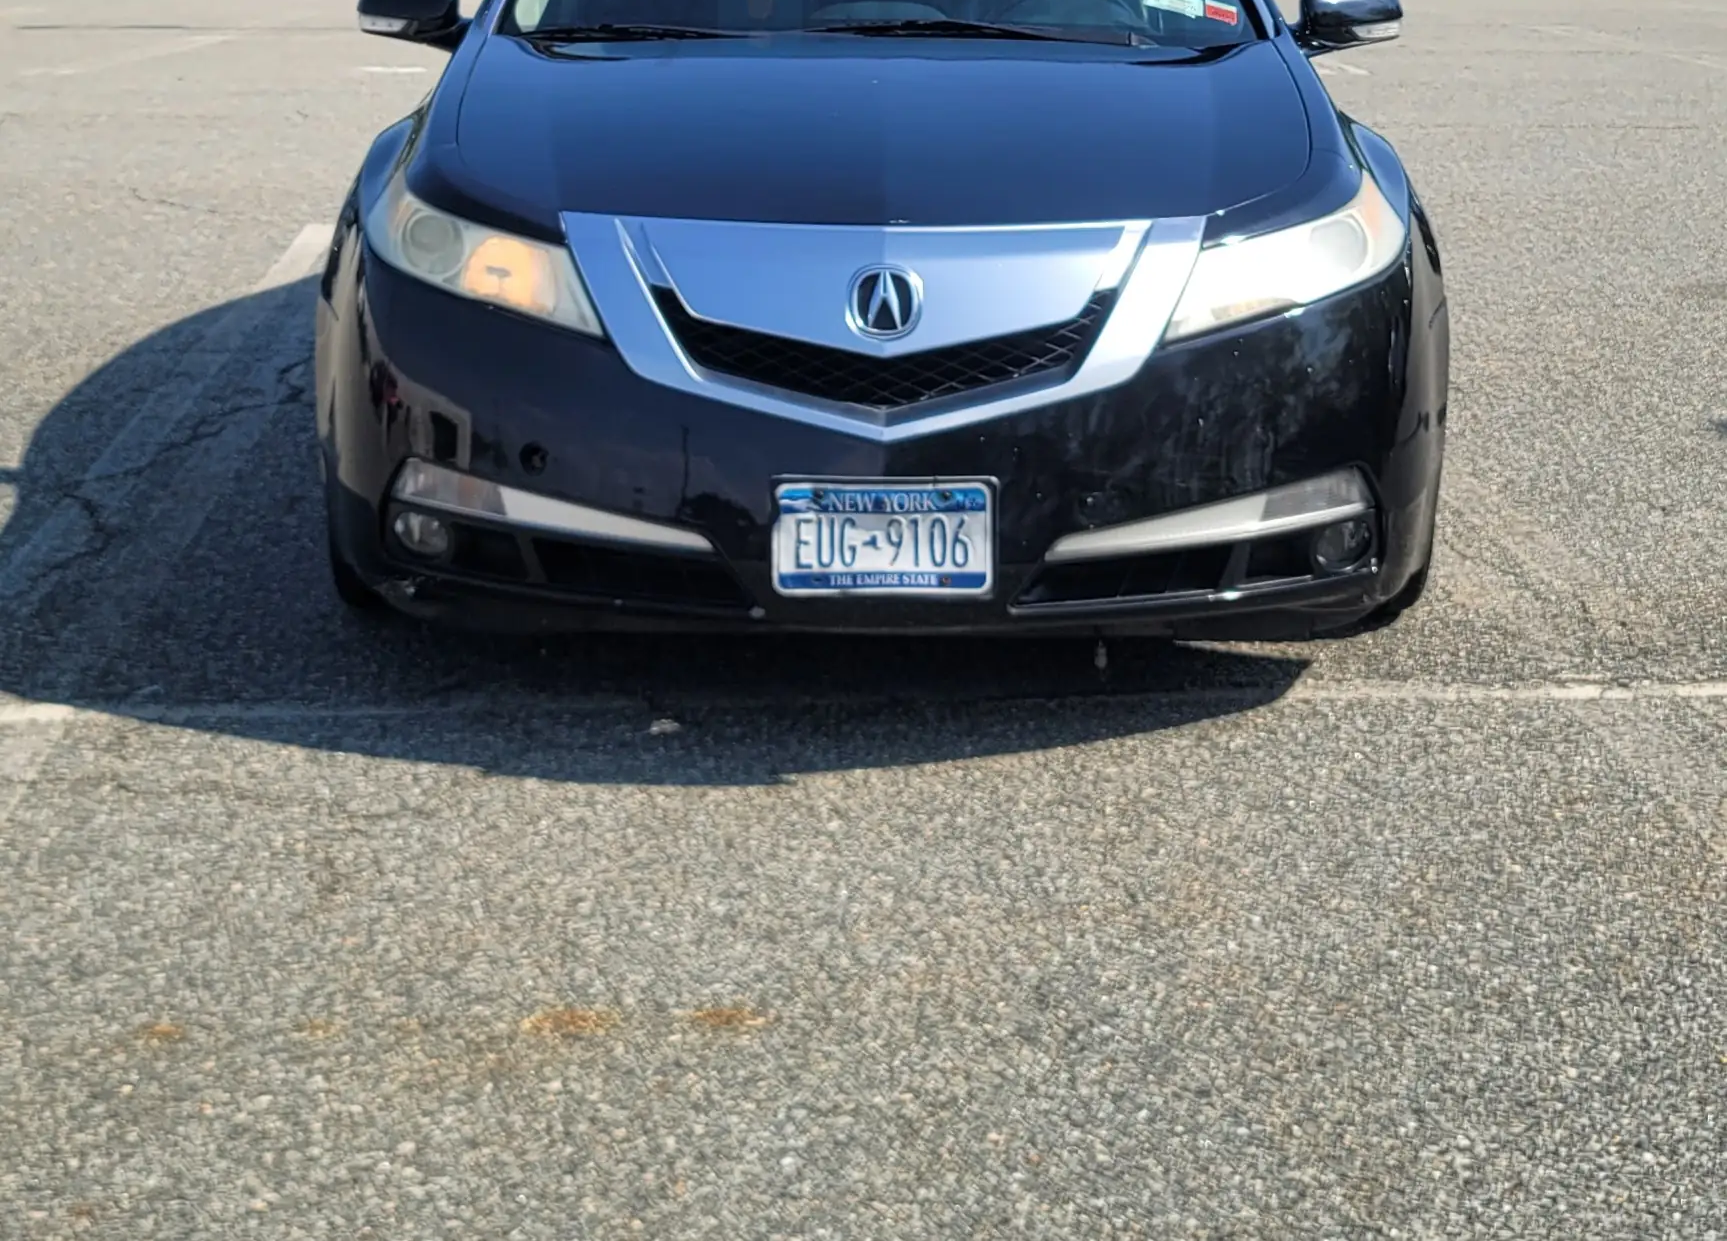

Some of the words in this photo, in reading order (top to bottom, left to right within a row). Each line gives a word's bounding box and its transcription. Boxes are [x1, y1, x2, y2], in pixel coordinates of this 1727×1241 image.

[828, 492, 875, 511] NEW
[881, 492, 938, 511] YORK
[794, 517, 856, 570] EUG
[886, 516, 970, 569] 9106
[830, 573, 853, 586] THE
[856, 573, 899, 586] EMPIRE
[902, 573, 939, 586] STATE
